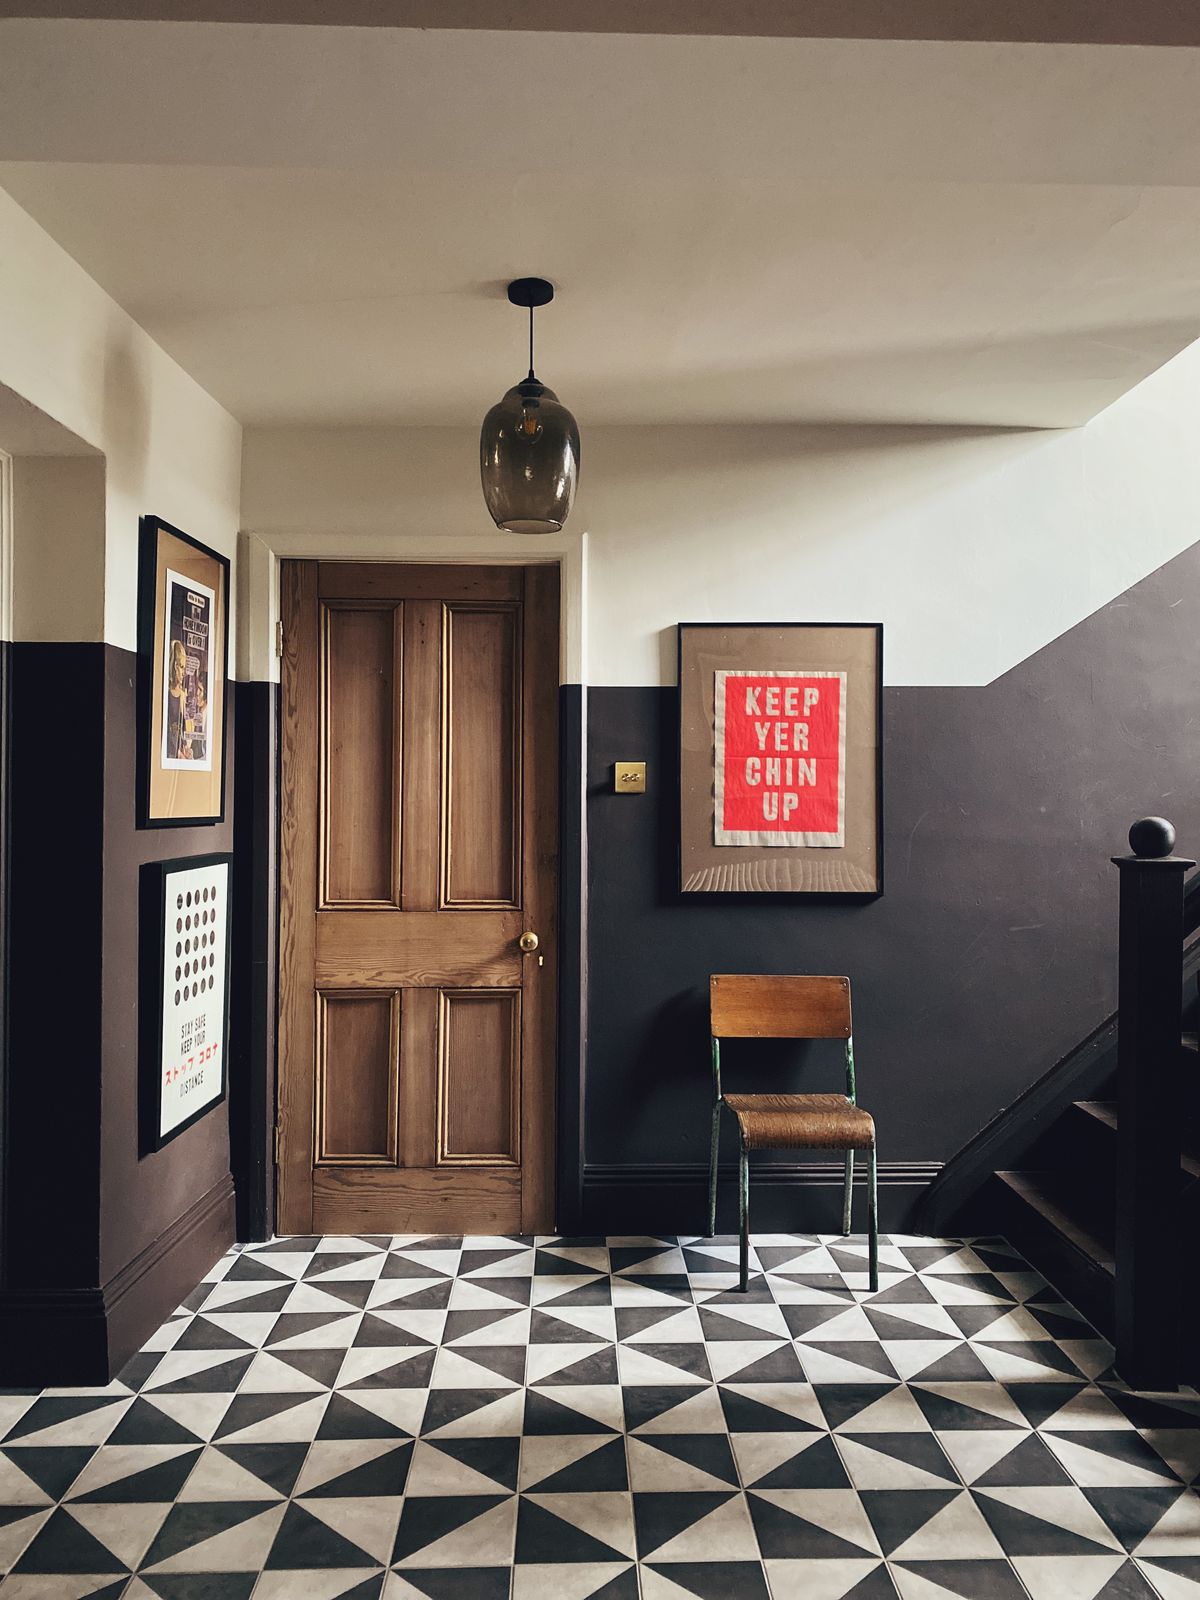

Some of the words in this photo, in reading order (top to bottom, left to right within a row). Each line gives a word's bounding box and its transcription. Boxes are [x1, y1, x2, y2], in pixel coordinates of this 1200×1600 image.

[745, 686, 820, 717] KEEP
[755, 721, 809, 751] YER
[745, 756, 817, 787] CHIN
[763, 791, 799, 821] UP
[181, 1020, 193, 1039] STAY
[195, 1013, 206, 1032] SAFE
[181, 1037, 193, 1056] KEEP
[194, 1030, 206, 1049] YOUR
[180, 1070, 204, 1097] DISTANCE
